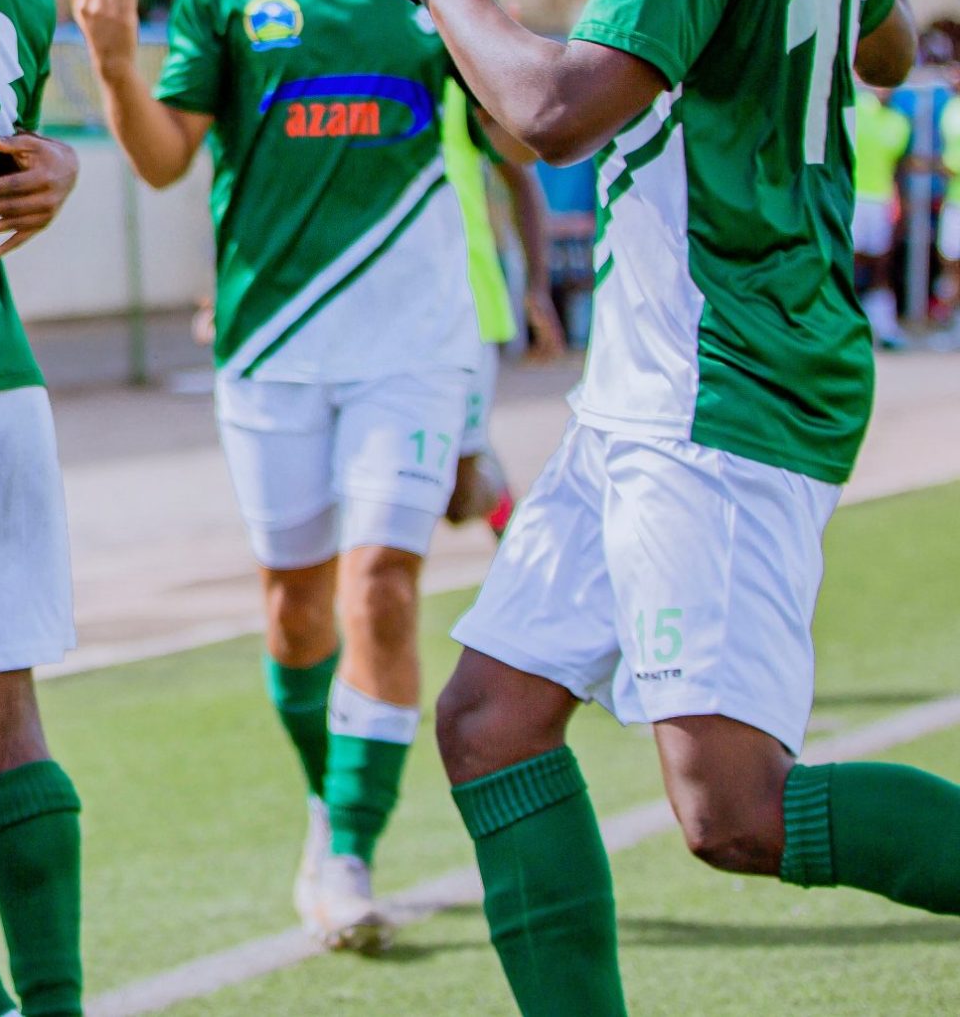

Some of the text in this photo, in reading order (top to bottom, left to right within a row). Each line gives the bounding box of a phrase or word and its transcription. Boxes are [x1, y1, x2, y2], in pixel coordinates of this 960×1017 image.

[284, 101, 381, 138] azam
[409, 429, 452, 470] 17
[635, 608, 683, 665] 15
